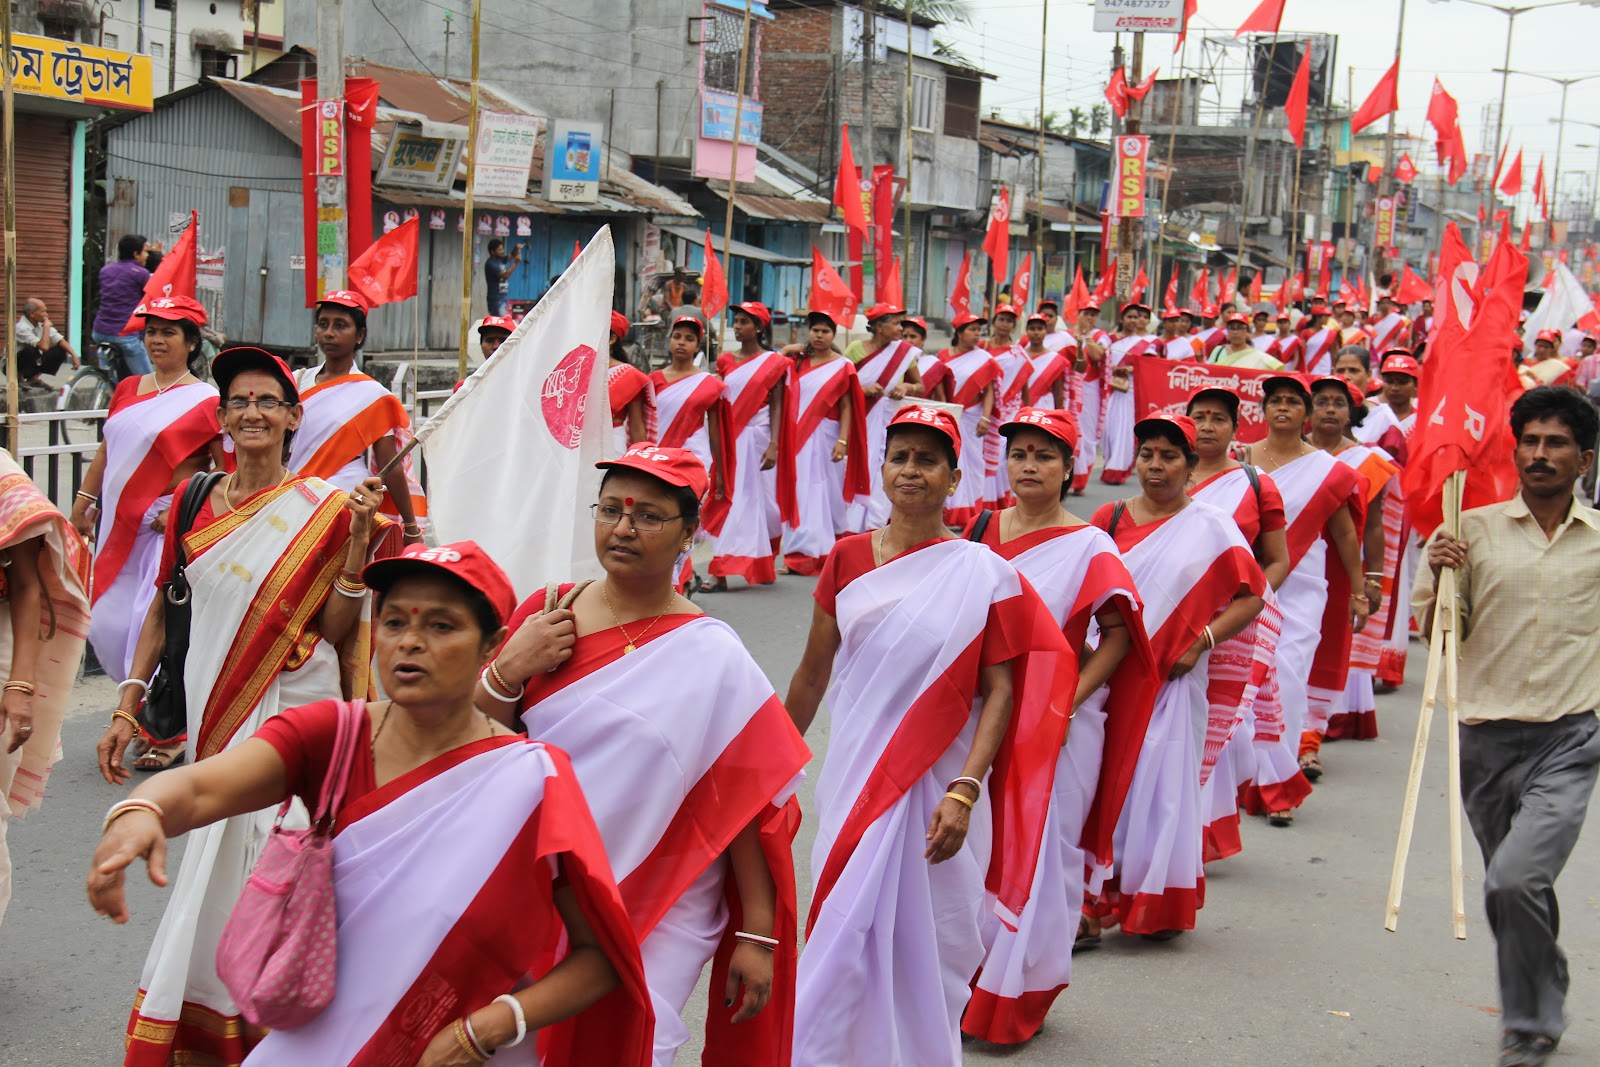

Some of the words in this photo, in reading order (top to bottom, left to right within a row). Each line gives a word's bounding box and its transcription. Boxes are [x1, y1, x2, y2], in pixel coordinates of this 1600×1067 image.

[1104, 0, 1171, 8] 9474873727
[51, 44, 134, 96] ট্রেডার্স
[322, 120, 339, 174] RSP
[1122, 158, 1142, 216] RSP
[1378, 211, 1391, 246] RSP
[1019, 415, 1053, 425] RSP
[624, 448, 671, 462] RSP
